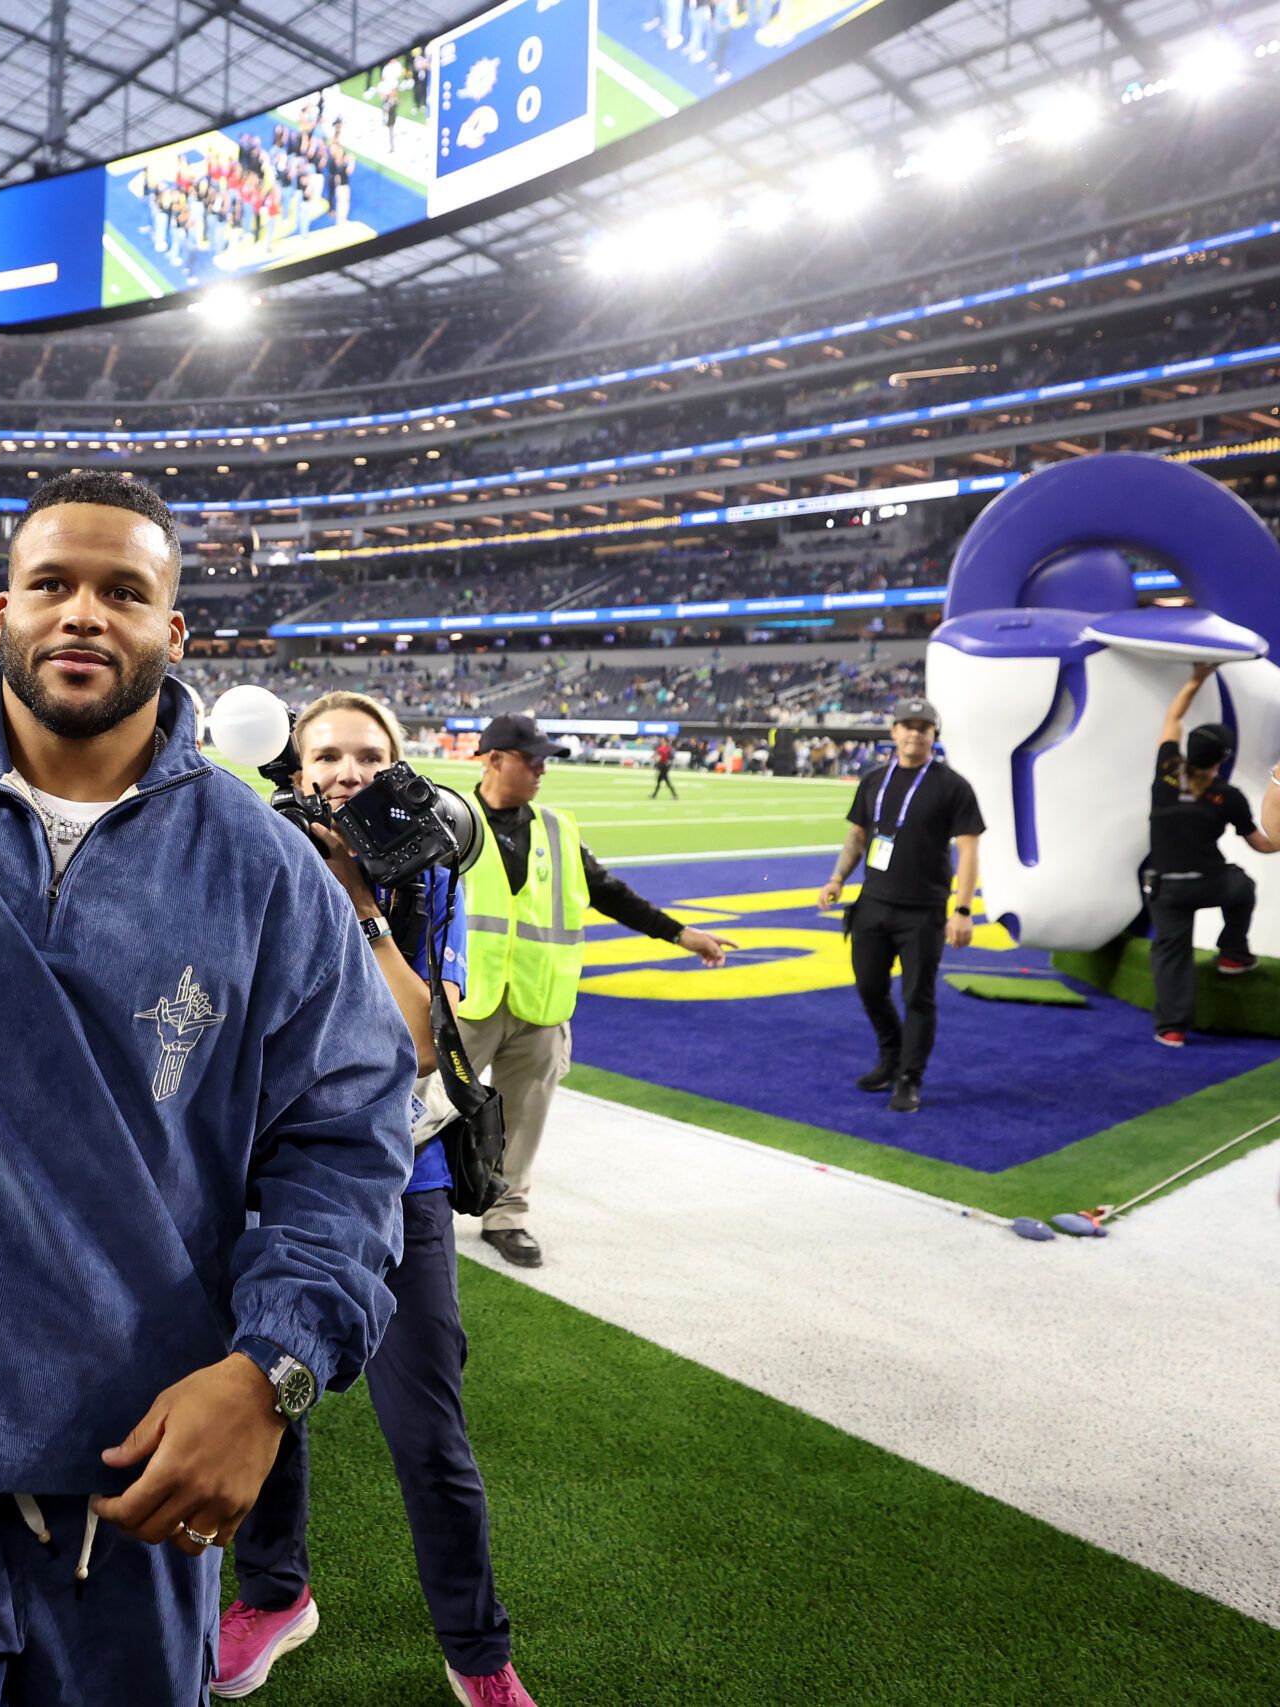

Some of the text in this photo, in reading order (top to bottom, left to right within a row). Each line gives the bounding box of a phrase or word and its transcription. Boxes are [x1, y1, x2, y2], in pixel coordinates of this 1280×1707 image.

[518, 35, 543, 74] 0
[516, 85, 542, 124] 0
[450, 1050, 471, 1085] Nikon
